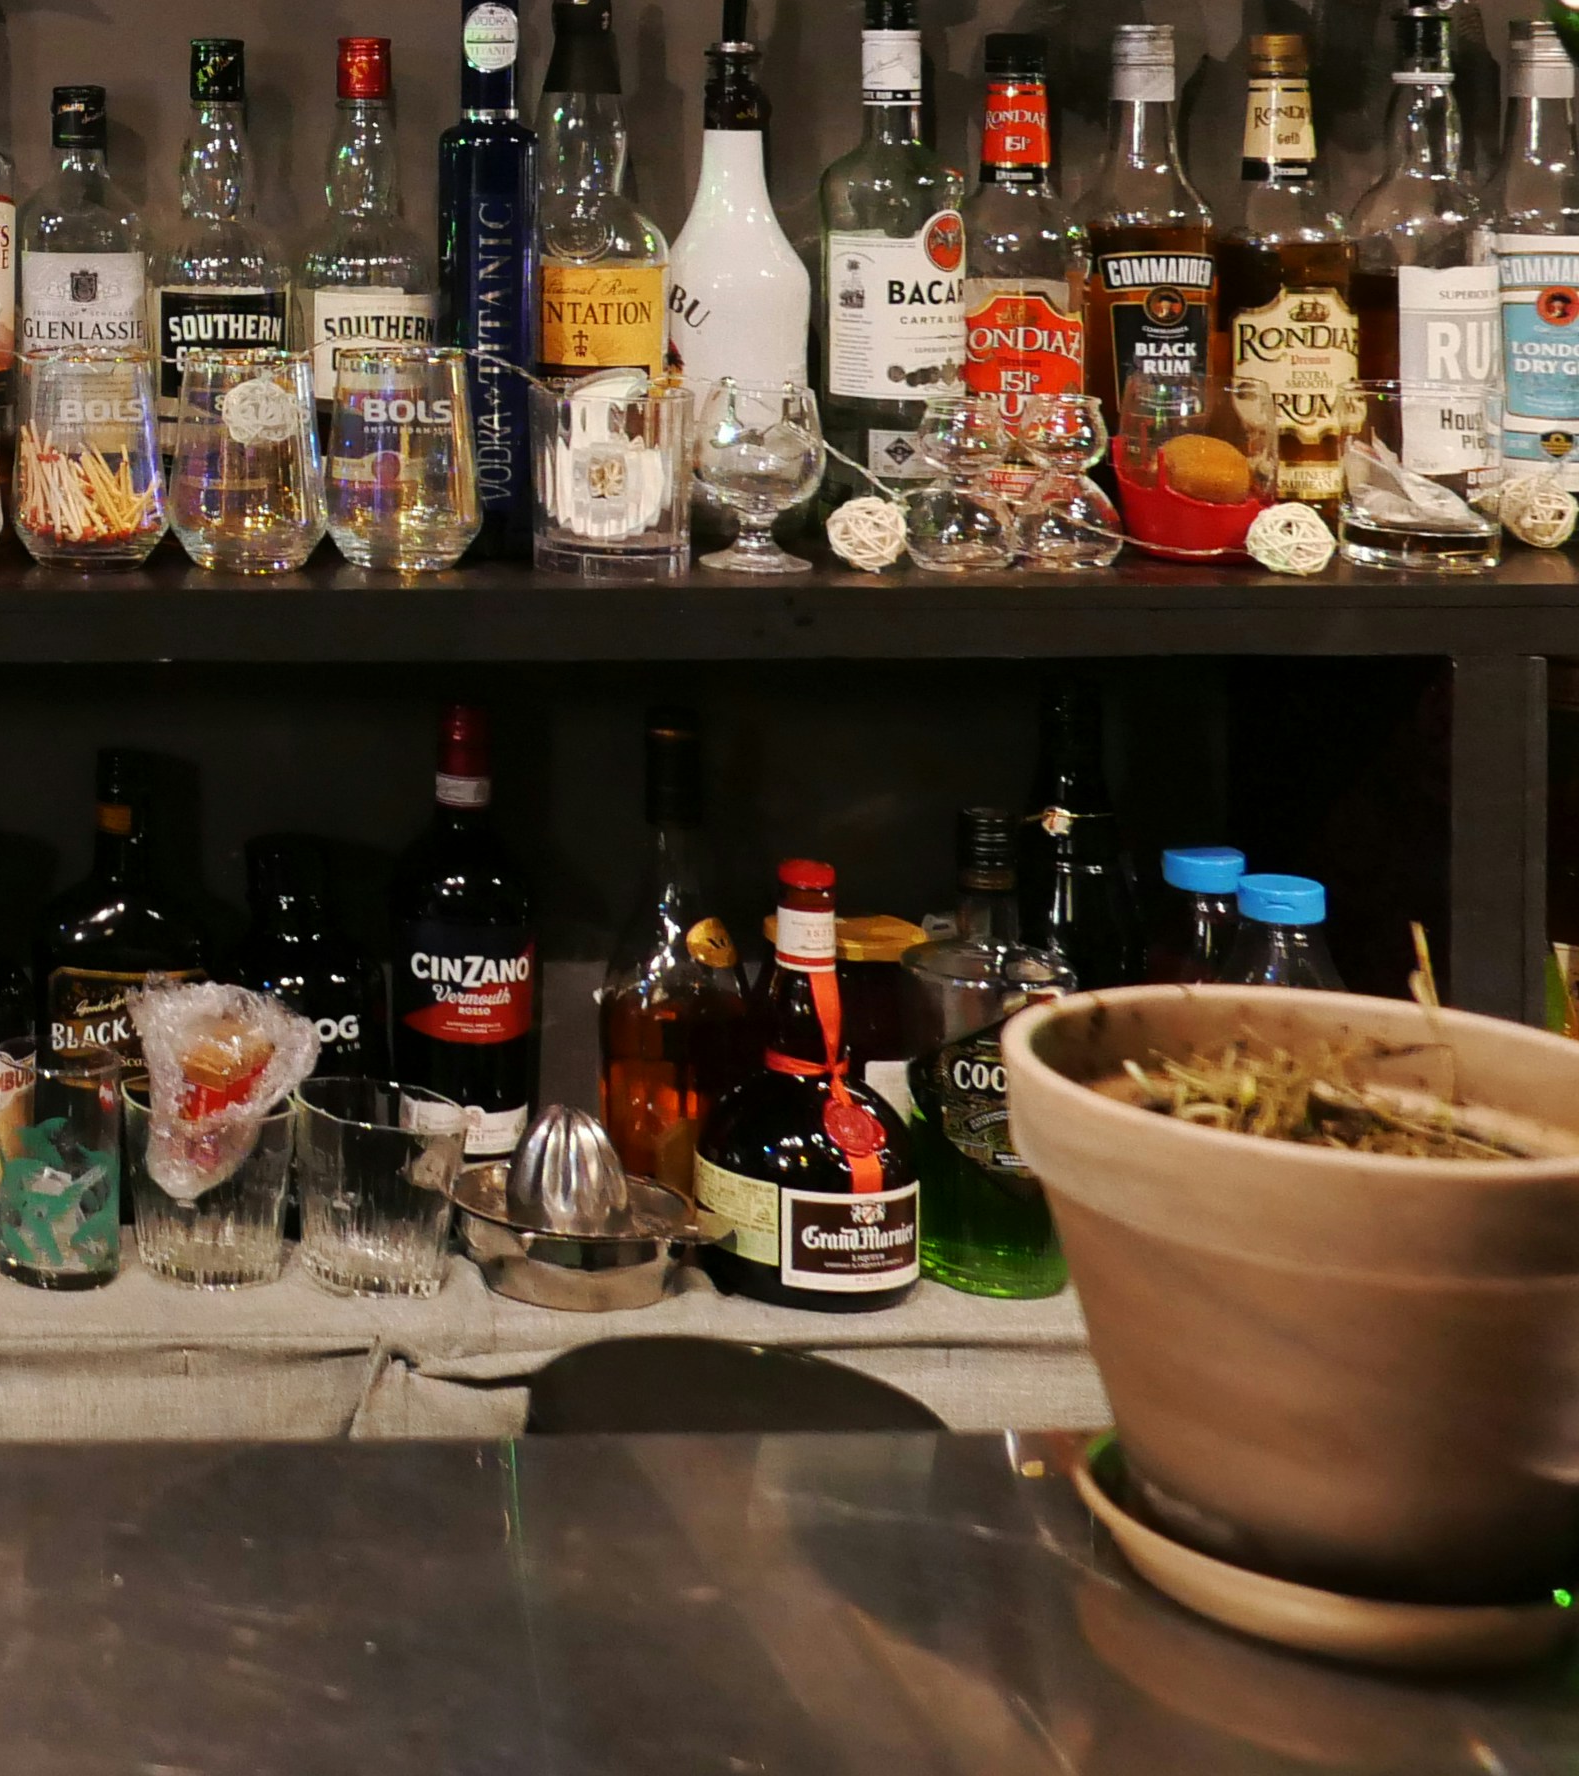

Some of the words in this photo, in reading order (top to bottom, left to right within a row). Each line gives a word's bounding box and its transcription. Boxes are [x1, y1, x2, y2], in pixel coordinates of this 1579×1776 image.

[1106, 255, 1213, 287] COMMANDER
[887, 280, 964, 305] BACAR
[23, 317, 143, 340] GLENLASSIE
[169, 313, 283, 342] SOUTHERN
[324, 315, 437, 341] SOUTHERN
[900, 316, 944, 325] CARTA
[1134, 341, 1198, 359] BLACK
[1511, 341, 1579, 359] LONDO
[1142, 358, 1192, 376] RUM
[1291, 371, 1330, 382] EXTRA
[1515, 358, 1559, 375] DRY
[1285, 379, 1334, 391] SMOOTH
[59, 399, 144, 421] BOLS
[363, 398, 454, 424] BOLS
[410, 952, 530, 988] CINZANO
[432, 983, 512, 1006] Vermouth
[457, 1007, 491, 1016] ROSSO
[50, 1016, 130, 1052] BLACK
